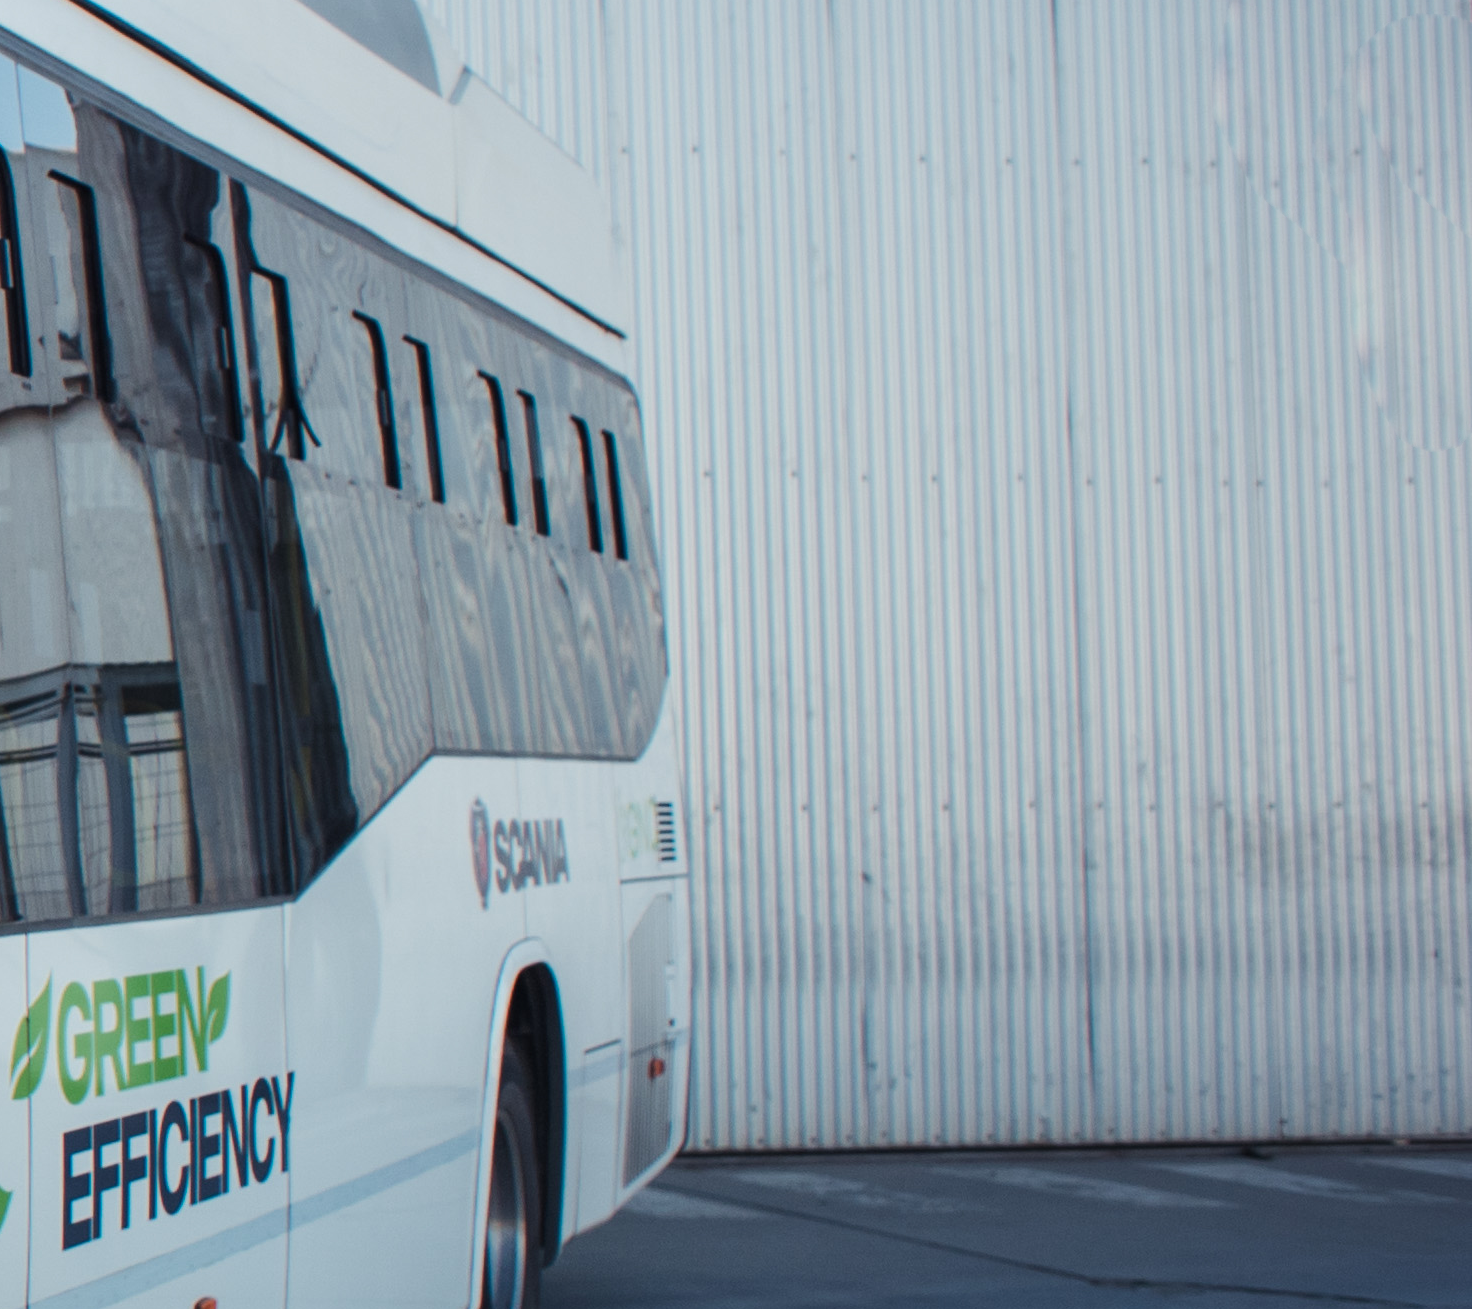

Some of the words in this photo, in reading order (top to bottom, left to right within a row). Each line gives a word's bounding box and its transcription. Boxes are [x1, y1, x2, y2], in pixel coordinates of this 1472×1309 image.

[493, 818, 570, 894] SCANIA
[56, 965, 210, 1106] GREEN
[61, 1070, 296, 1252] EFFICIENCY
